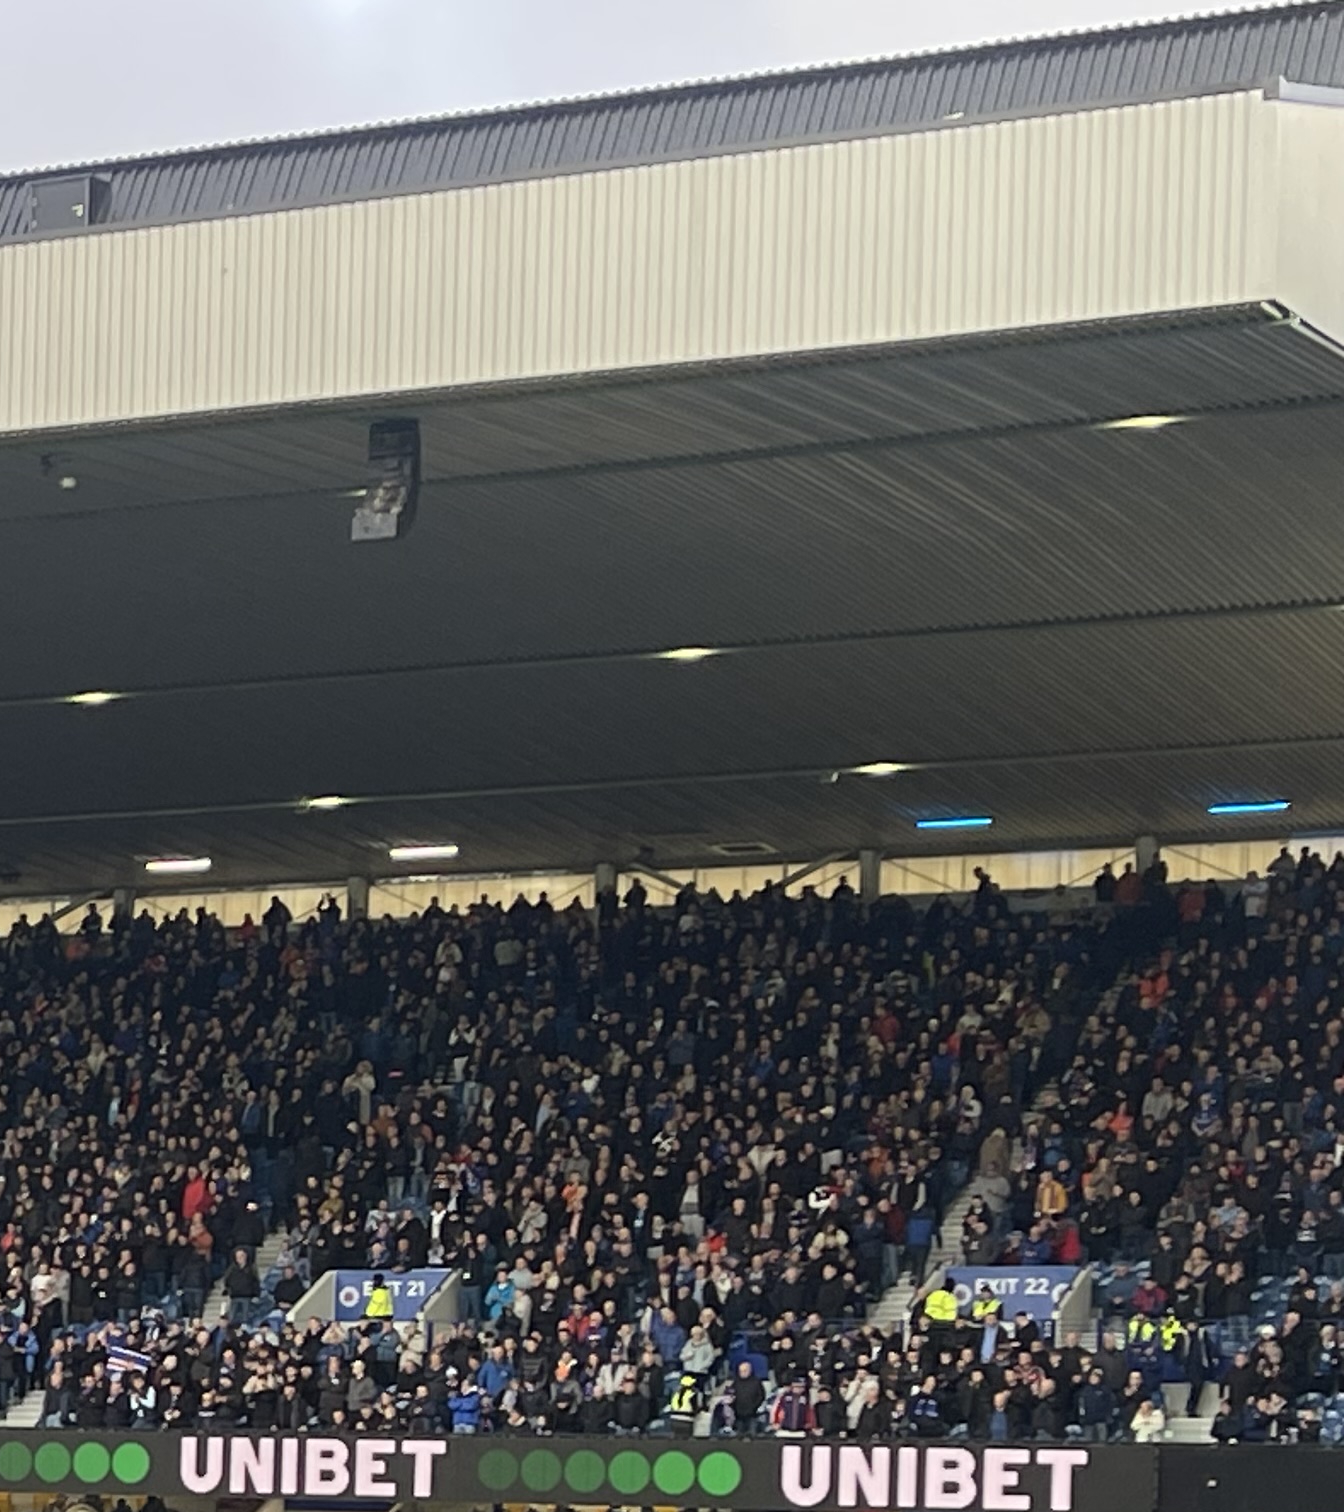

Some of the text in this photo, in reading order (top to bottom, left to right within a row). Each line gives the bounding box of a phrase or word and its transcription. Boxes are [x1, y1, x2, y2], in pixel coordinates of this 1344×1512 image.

[406, 1280, 426, 1297] 21
[974, 1278, 1050, 1295] EXIT 22
[179, 1438, 447, 1500] UNIBET
[780, 1447, 1089, 1512] UNIBET
